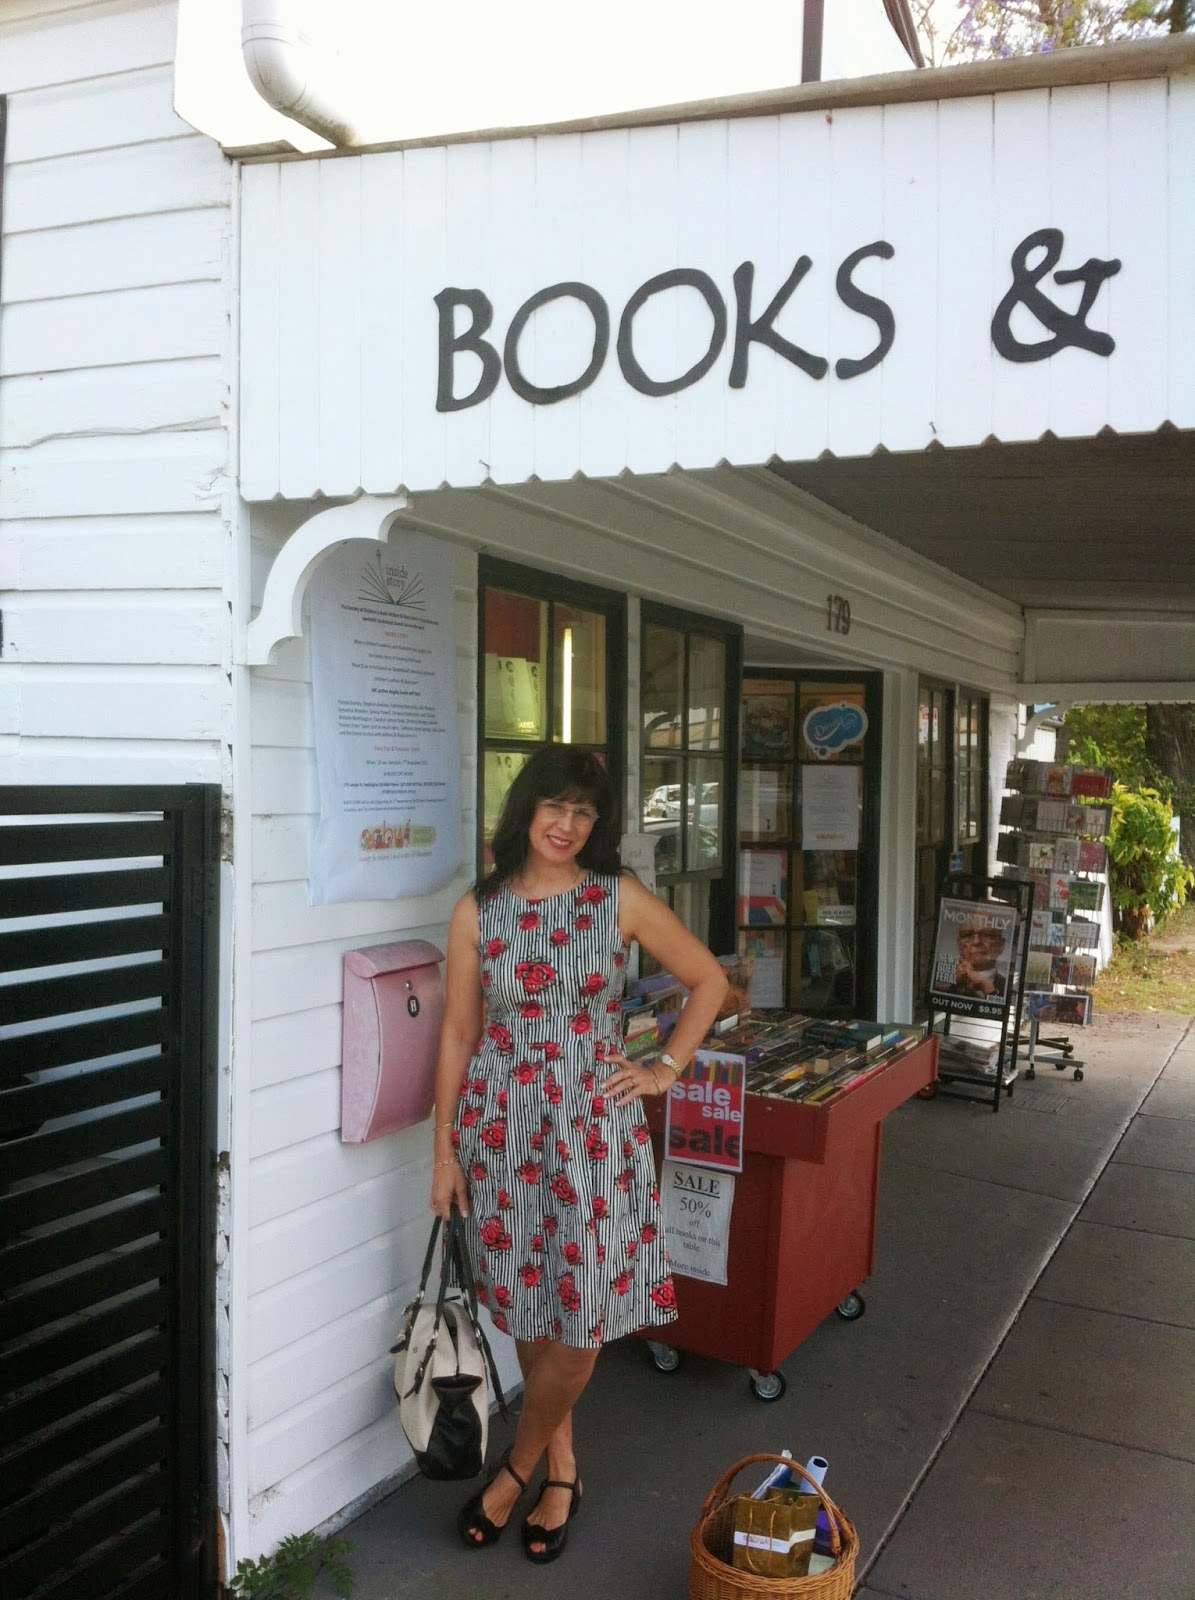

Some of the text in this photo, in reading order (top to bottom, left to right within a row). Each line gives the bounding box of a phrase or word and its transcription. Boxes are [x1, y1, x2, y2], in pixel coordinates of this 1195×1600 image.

[434, 228, 1122, 412] BOOKS &
[826, 594, 851, 635] 179
[943, 909, 1011, 930] MONTHLY
[937, 961, 957, 973] GOES
[931, 996, 1003, 1015] OUT NOW $9.95
[671, 1081, 732, 1107] sale
[701, 1105, 742, 1122] sale
[669, 1125, 741, 1160] sale
[674, 1170, 720, 1195] SALE
[680, 1197, 712, 1218] 50%
[689, 1219, 701, 1229] off
[676, 1228, 697, 1241] books
[708, 1236, 721, 1248] this
[670, 1259, 688, 1270] More
